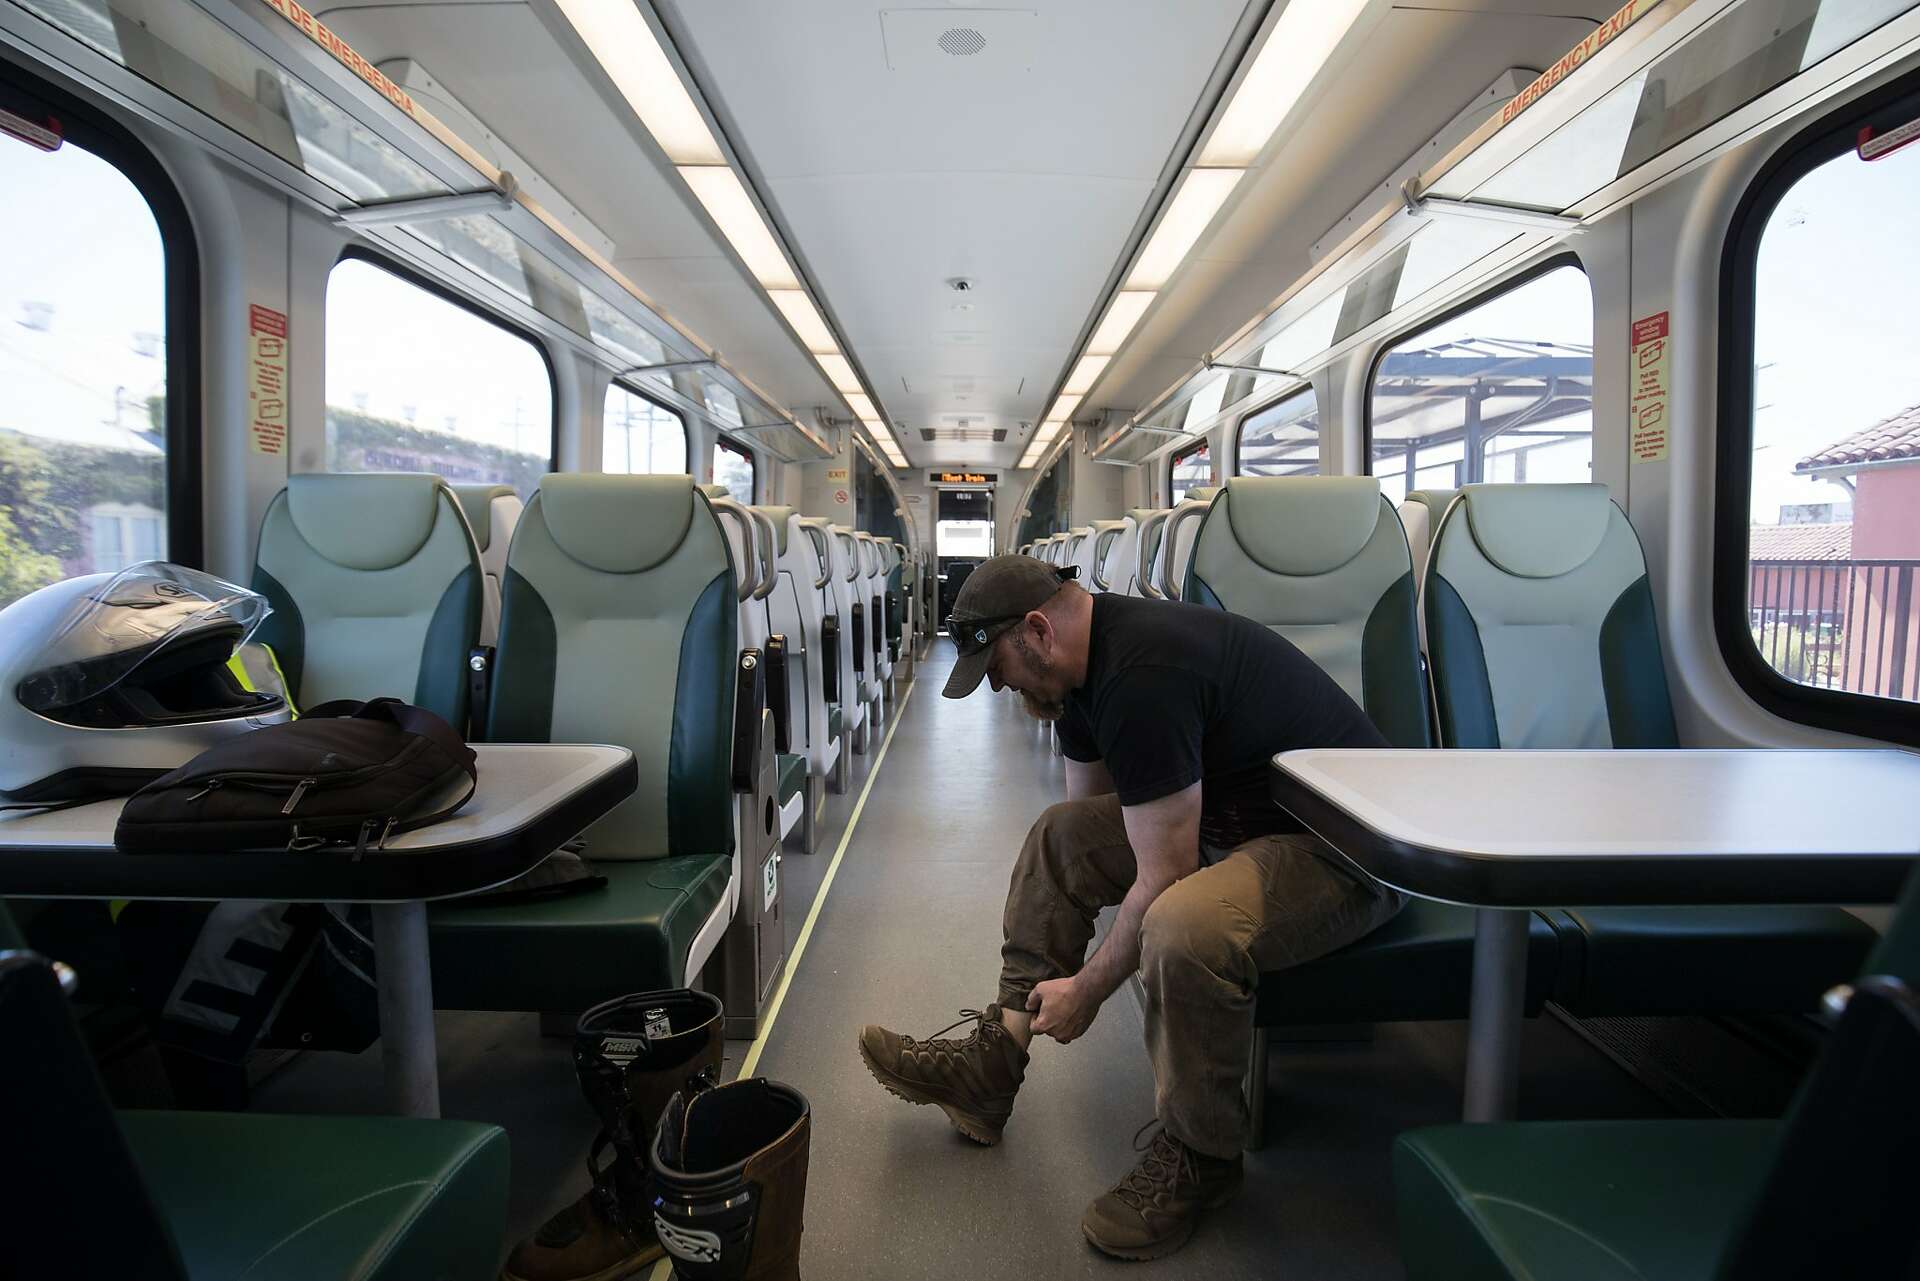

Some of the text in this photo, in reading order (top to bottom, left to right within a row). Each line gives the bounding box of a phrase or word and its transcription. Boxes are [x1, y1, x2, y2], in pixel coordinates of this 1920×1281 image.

[289, 1, 313, 34] DE
[317, 25, 414, 114] EMERGENCIA
[1502, 0, 1638, 123] EMERGENCY EXIT
